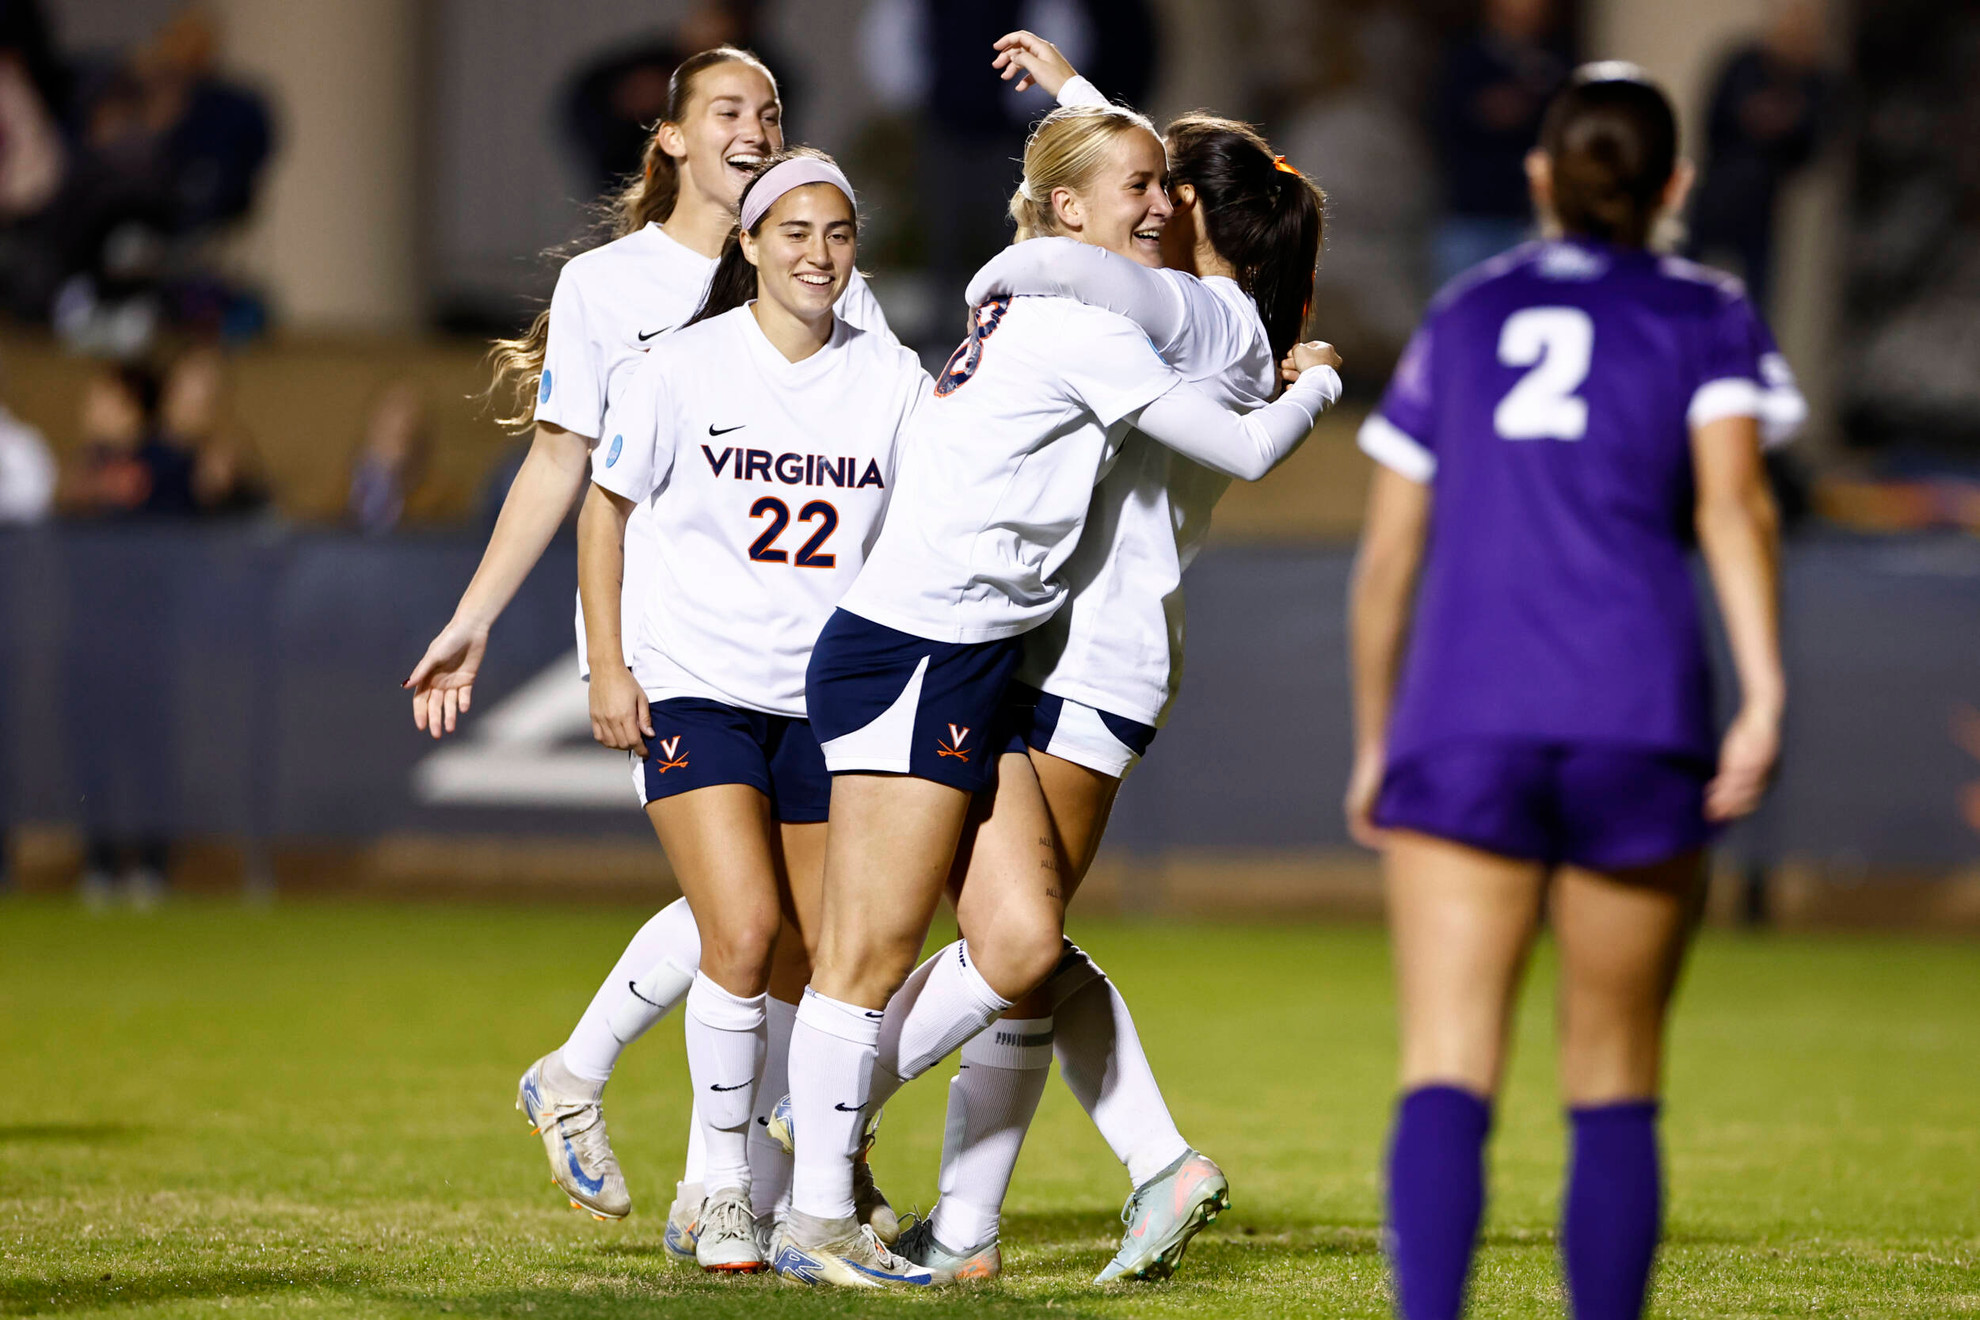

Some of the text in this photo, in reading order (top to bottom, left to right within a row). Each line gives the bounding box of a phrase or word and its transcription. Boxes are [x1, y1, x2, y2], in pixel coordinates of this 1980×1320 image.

[1494, 305, 1594, 441] 2
[700, 444, 885, 489] VIRGINIA
[748, 496, 839, 568] 22
[660, 735, 681, 761] V
[948, 723, 970, 750] V
